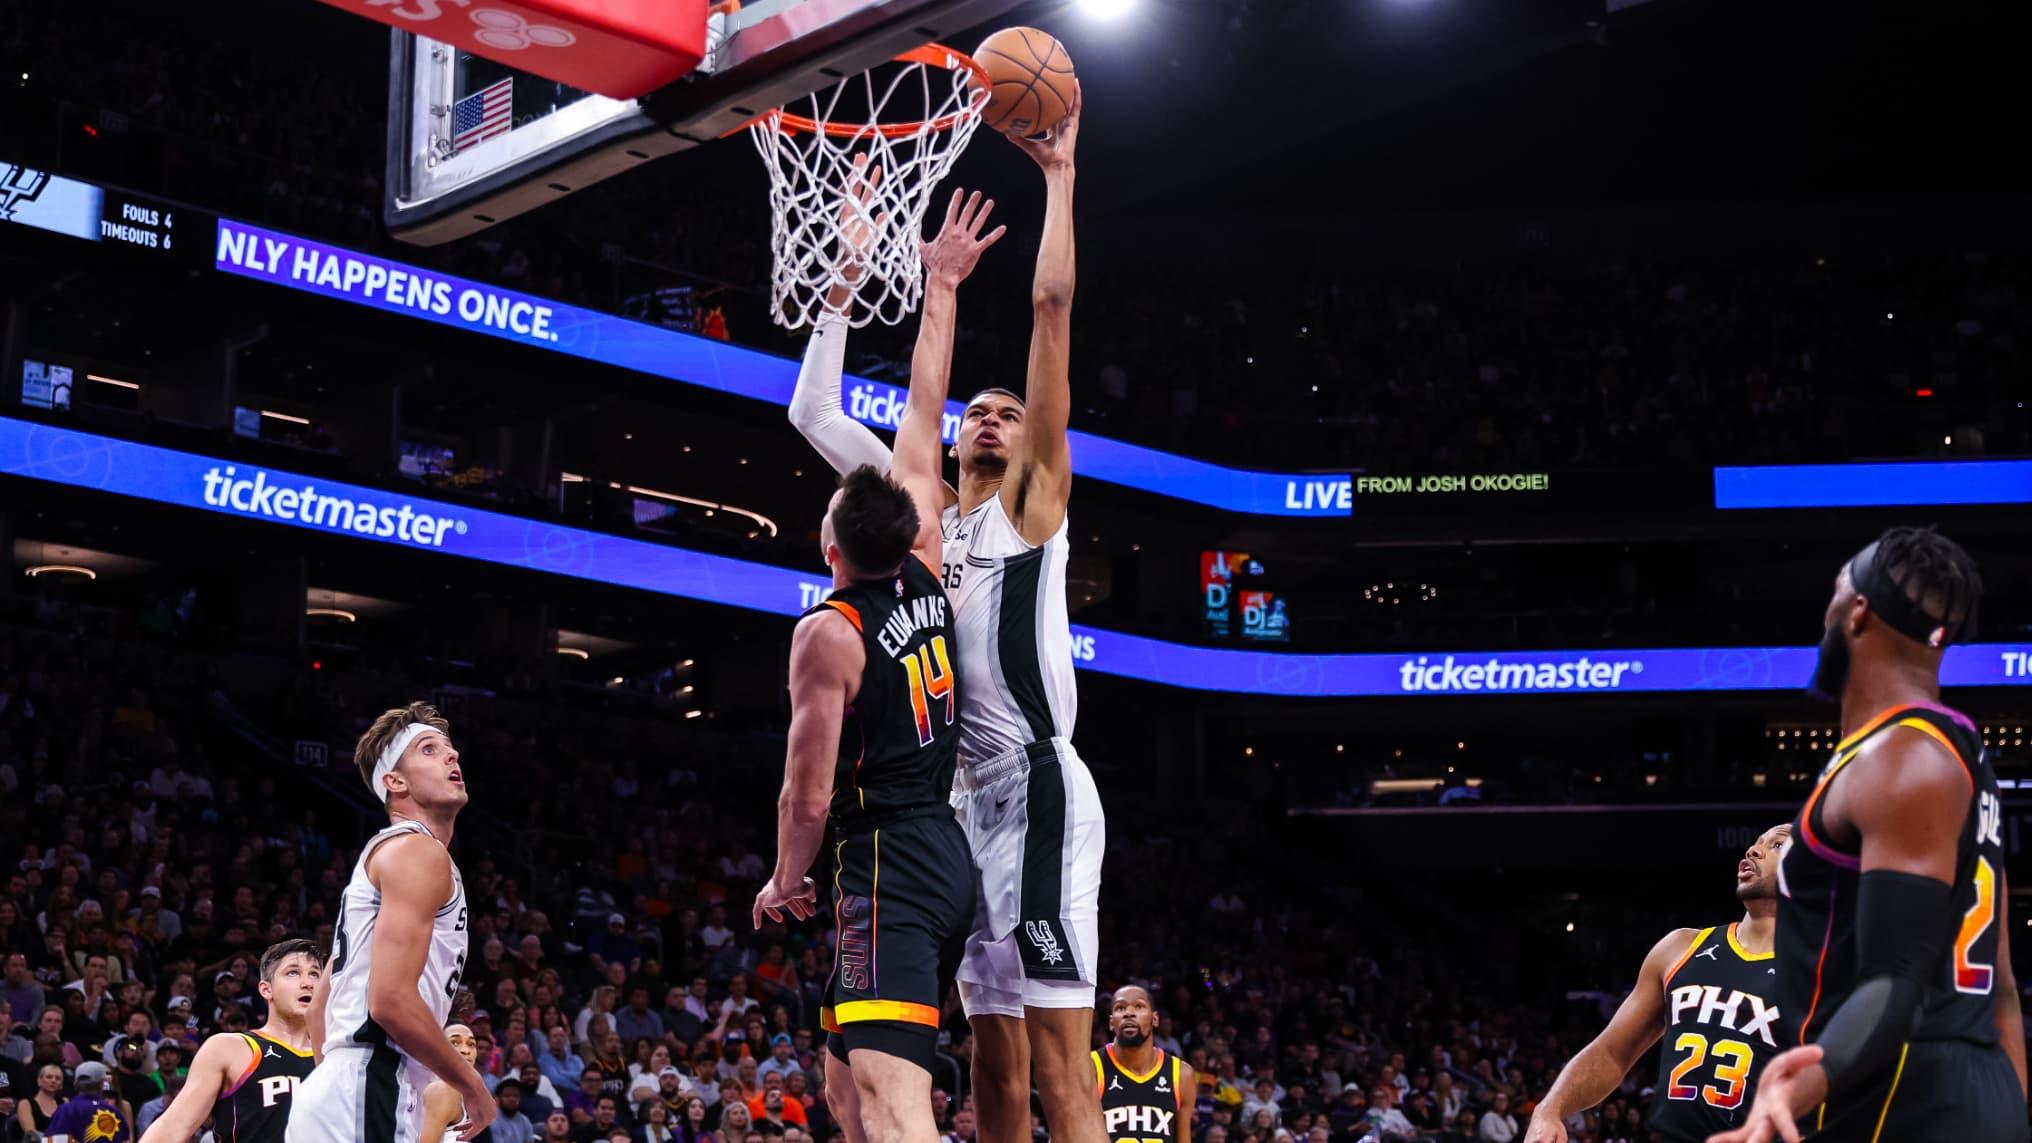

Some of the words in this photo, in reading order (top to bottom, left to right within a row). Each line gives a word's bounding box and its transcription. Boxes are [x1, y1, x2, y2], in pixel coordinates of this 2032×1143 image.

[123, 203, 159, 226] FOULS
[164, 213, 172, 228] 4
[101, 220, 157, 248] TIMEOUTS
[163, 234, 171, 249] 6
[217, 228, 289, 274] NLY
[292, 247, 452, 315] HAPPENS
[458, 289, 558, 342] ONCE.
[1285, 481, 1352, 509] LIVE
[1357, 477, 1412, 493] FROM
[1416, 476, 1466, 492] JOSH
[1470, 474, 1548, 491] OKOGIE!
[2001, 652, 2032, 677] TI
[900, 635, 954, 747] 14
[842, 896, 869, 990] SUNS
[1671, 985, 1780, 1048] PHX
[1668, 1033, 1754, 1110] 23
[1103, 1105, 1174, 1136] PHX
